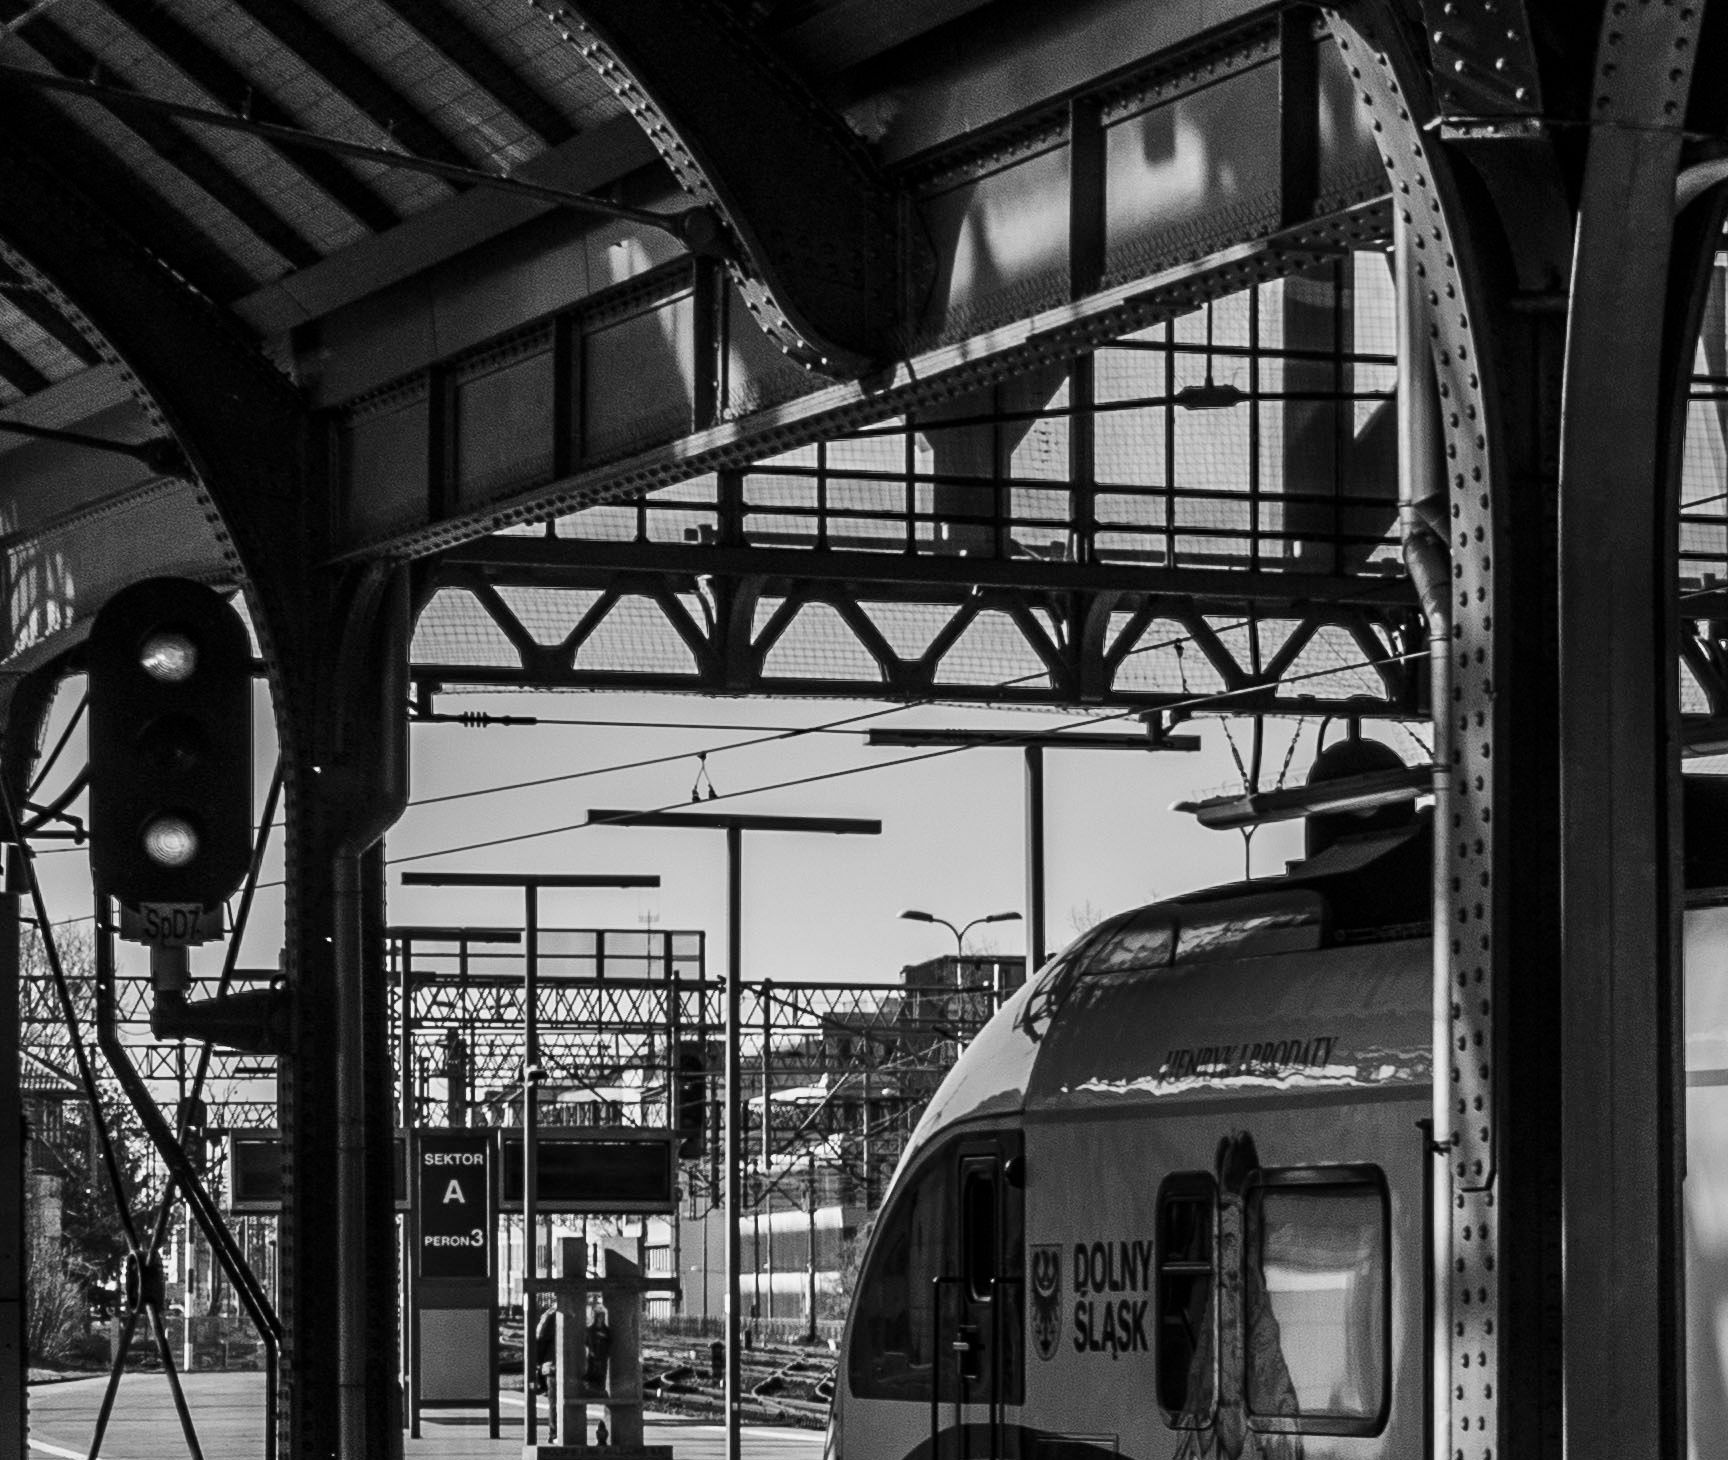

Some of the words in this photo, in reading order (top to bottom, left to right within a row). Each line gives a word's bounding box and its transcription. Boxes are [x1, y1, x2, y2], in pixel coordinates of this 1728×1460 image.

[424, 1153, 484, 1166] SEKTOR
[442, 1179, 466, 1204] A
[424, 1235, 469, 1248] PERON
[470, 1228, 484, 1247] 3
[1073, 1241, 1153, 1294] DOLNY
[1073, 1290, 1148, 1360] ŚLĄSK
